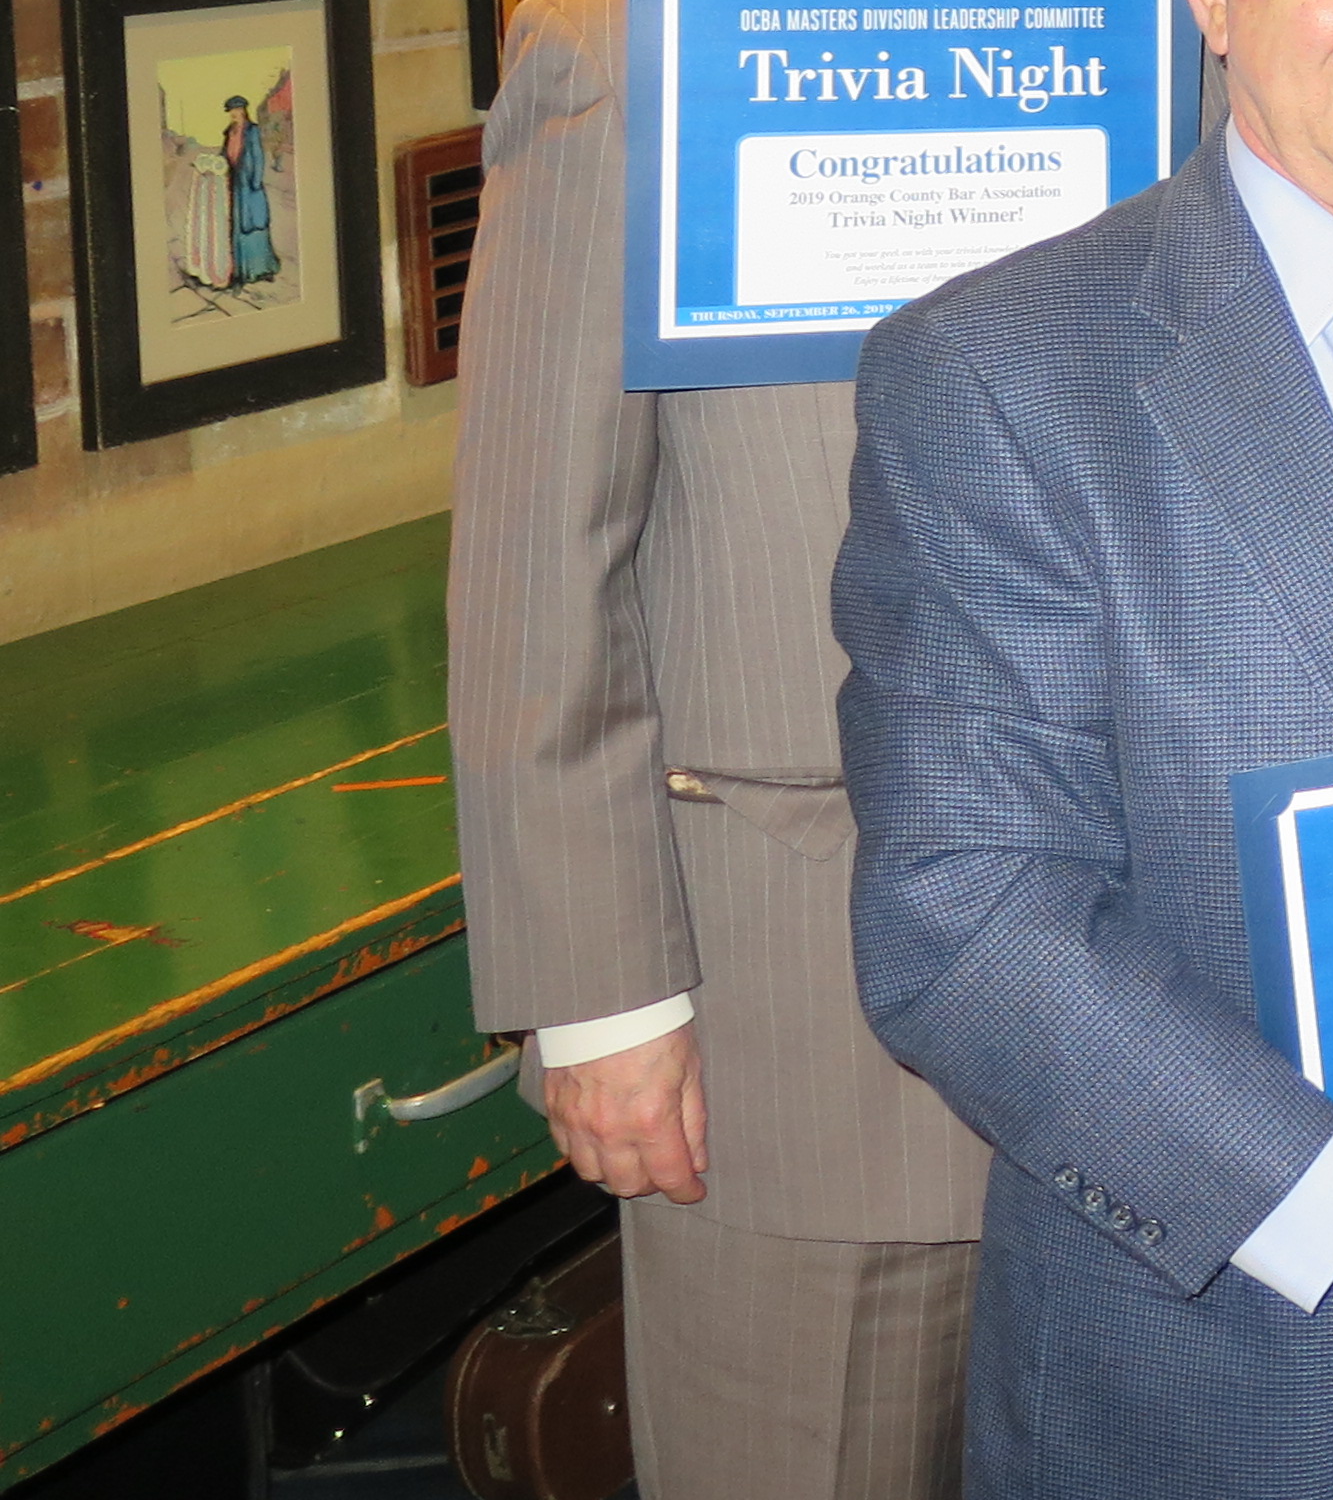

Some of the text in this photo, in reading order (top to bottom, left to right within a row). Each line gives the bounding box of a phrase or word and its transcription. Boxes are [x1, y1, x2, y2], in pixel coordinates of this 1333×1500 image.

[740, 6, 1105, 32] OCBA MASTERS DIVISION LEADERSHIP COMMITTEE
[738, 45, 1108, 114] Trivia Night
[788, 144, 1062, 185] Congratulations
[788, 184, 1062, 207] 2019 Orange County Bar Association
[827, 205, 1024, 230] Trivia Night Winner!
[841, 302, 893, 316] 26, 2019
